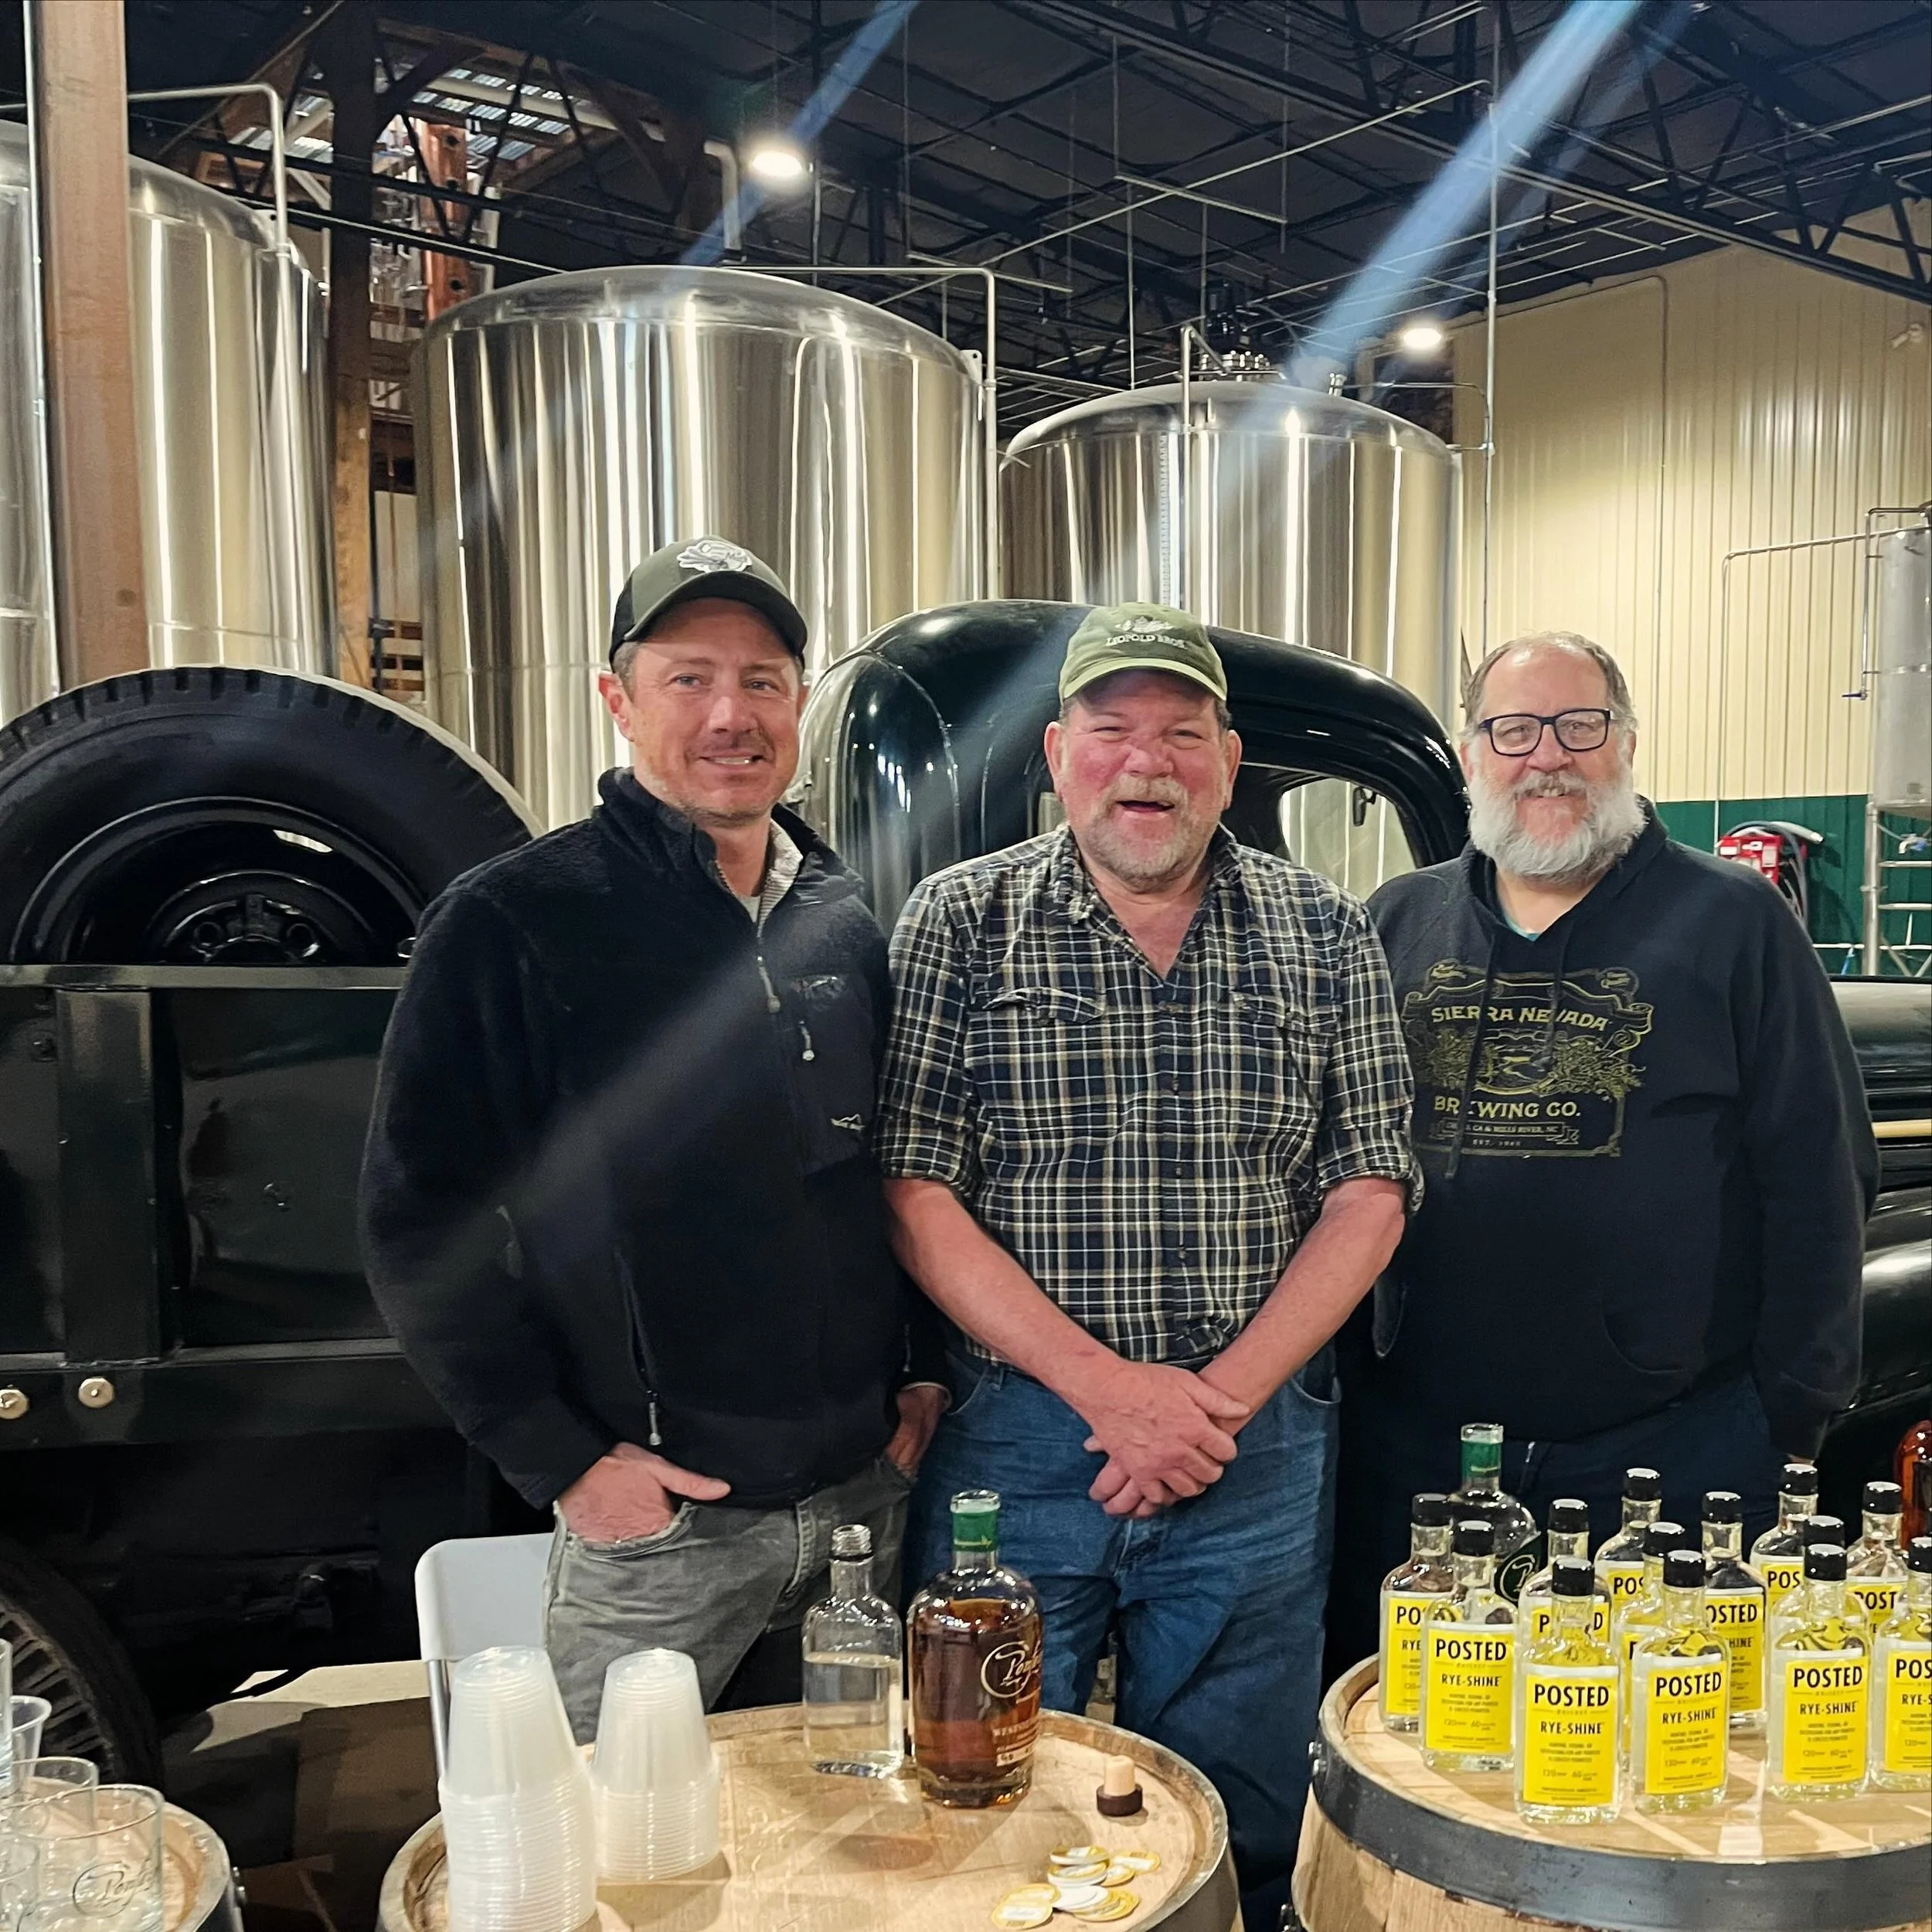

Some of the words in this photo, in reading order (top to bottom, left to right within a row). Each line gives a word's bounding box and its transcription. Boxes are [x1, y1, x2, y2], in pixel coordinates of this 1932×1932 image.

[1430, 1005, 1515, 1023] SIERRA
[1434, 1094, 1540, 1119] BRWING
[1546, 1101, 1581, 1117] CO.
[1436, 1638, 1506, 1661] POSTED
[1441, 1674, 1500, 1687] RYE-SHINE
[1656, 1672, 1722, 1697] POSTED
[1794, 1666, 1862, 1688] POSTED
[1534, 1684, 1609, 1707] POSTED
[1662, 1707, 1716, 1724] RYE-SHINE
[1800, 1701, 1855, 1715] RYE-SHINE
[1540, 1721, 1601, 1735] RYE-SHINE
